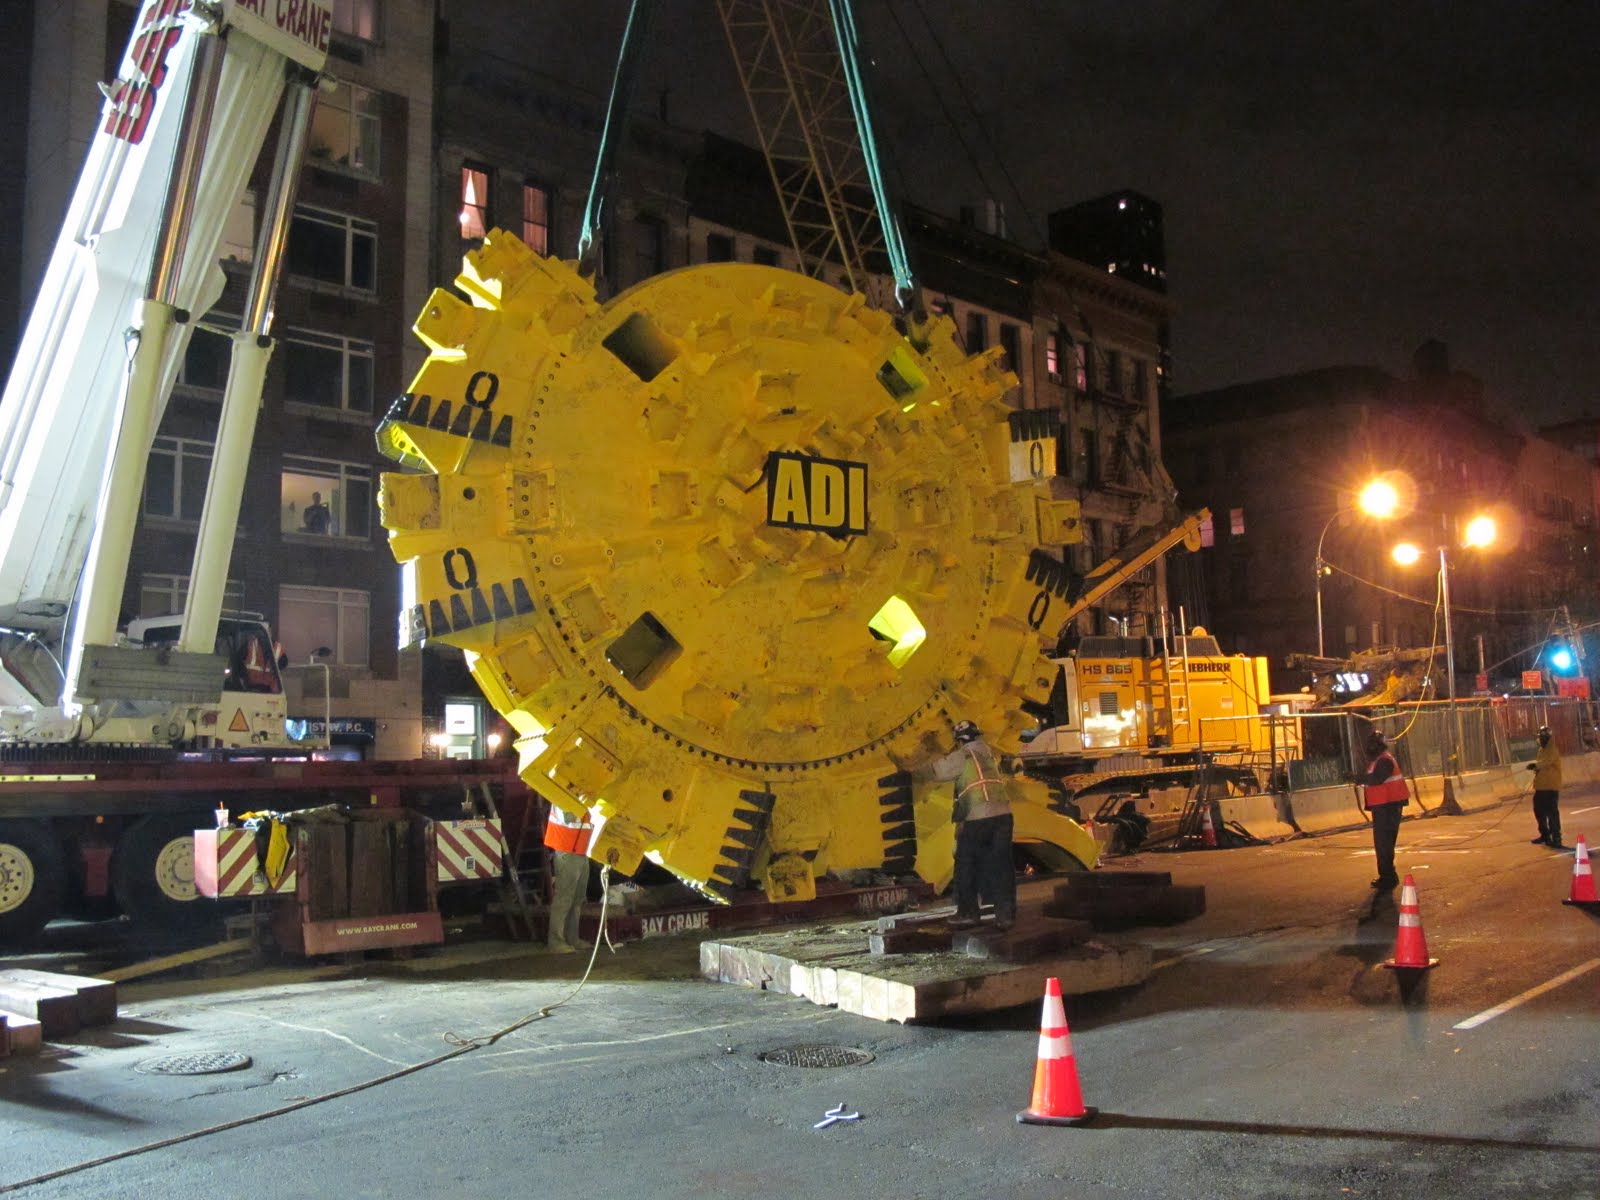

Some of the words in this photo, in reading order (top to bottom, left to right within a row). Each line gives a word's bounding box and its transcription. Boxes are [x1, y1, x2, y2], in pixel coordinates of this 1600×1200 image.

[276, 0, 331, 54] CRANE
[464, 371, 500, 411] Q
[771, 458, 865, 531] ADI
[443, 547, 479, 591] Q
[1083, 664, 1101, 675] HS
[1187, 662, 1231, 673] IEBHERR
[641, 916, 665, 935] BAY
[667, 911, 710, 934] CRANE
